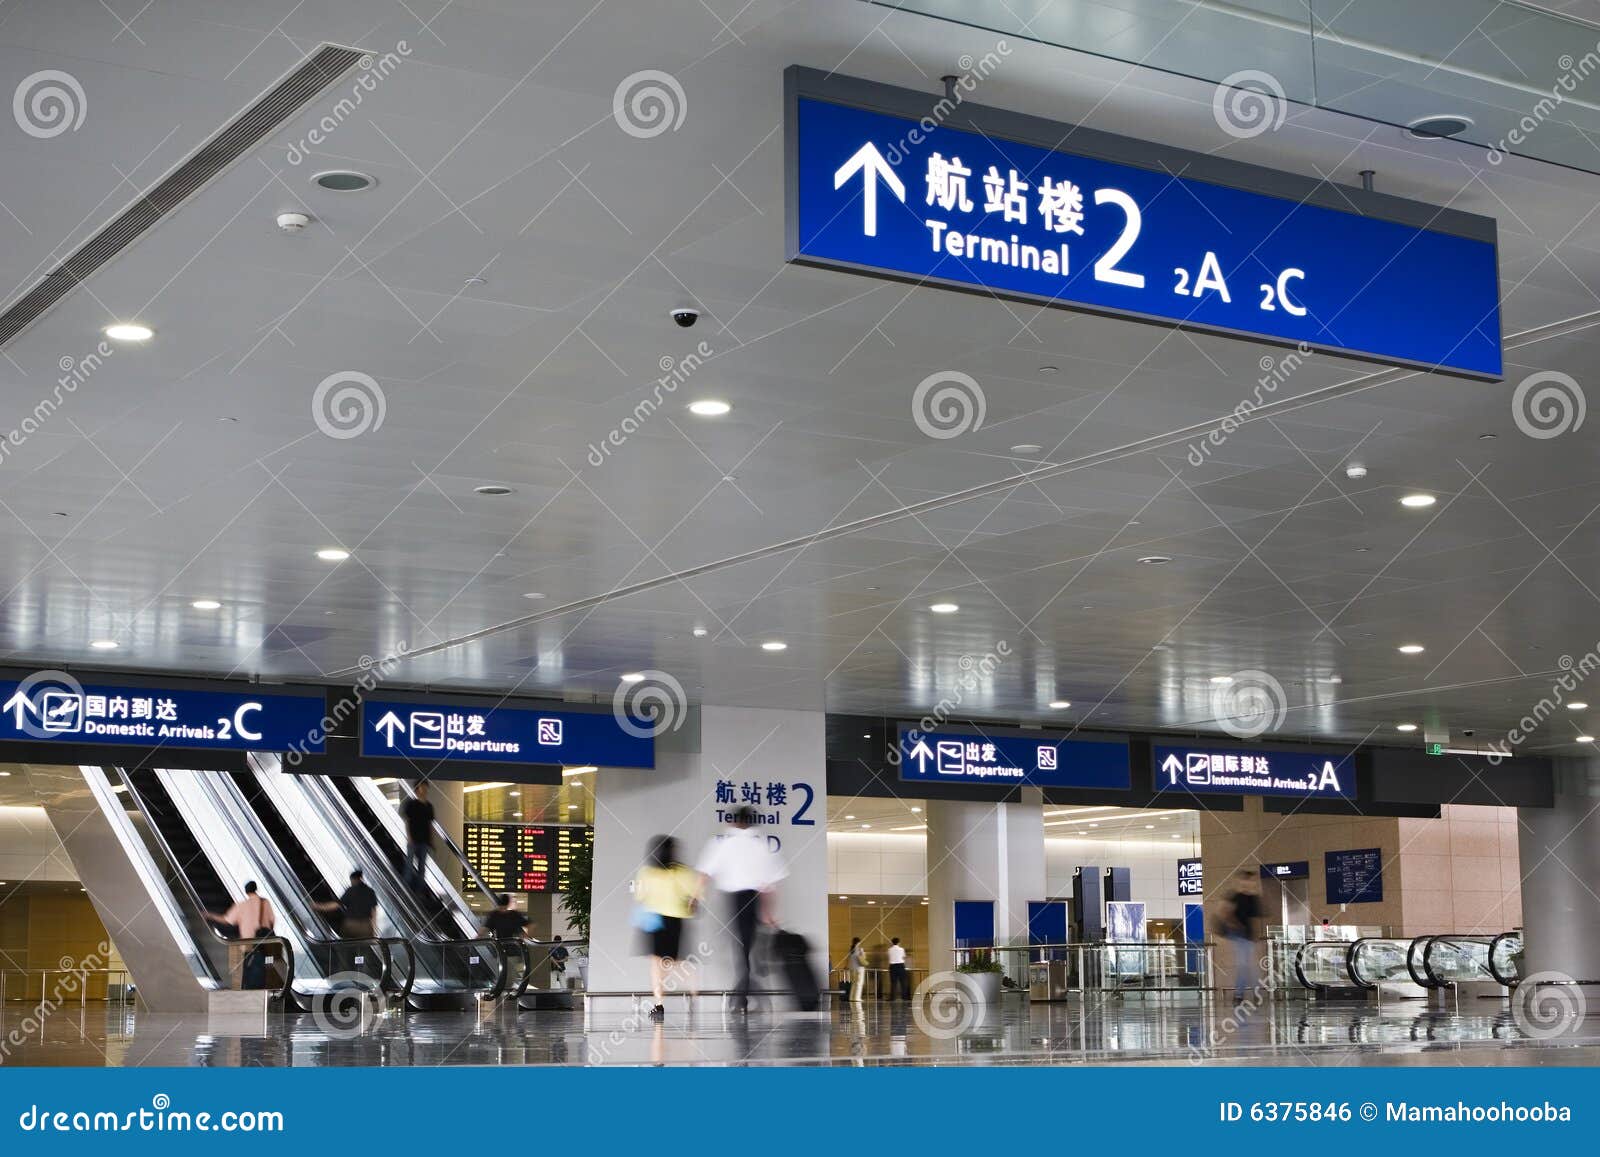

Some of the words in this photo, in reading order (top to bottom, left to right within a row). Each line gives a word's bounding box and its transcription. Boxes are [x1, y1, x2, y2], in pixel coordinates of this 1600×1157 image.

[925, 152, 1085, 236] 航站楼
[925, 219, 1070, 276] Terminal
[1094, 188, 1145, 289] 2
[85, 695, 178, 721] 国内到达
[85, 721, 154, 737] Domestic
[158, 725, 215, 740] Arrivals
[446, 714, 486, 735] 出发
[446, 738, 520, 753] Departures
[966, 742, 997, 762] 出发
[966, 764, 1024, 777] Departures
[1211, 755, 1270, 775] 国际到达
[1212, 775, 1272, 788] International
[1273, 777, 1307, 790] Arrivals
[716, 780, 788, 806] 航站楼
[791, 782, 816, 826] 2
